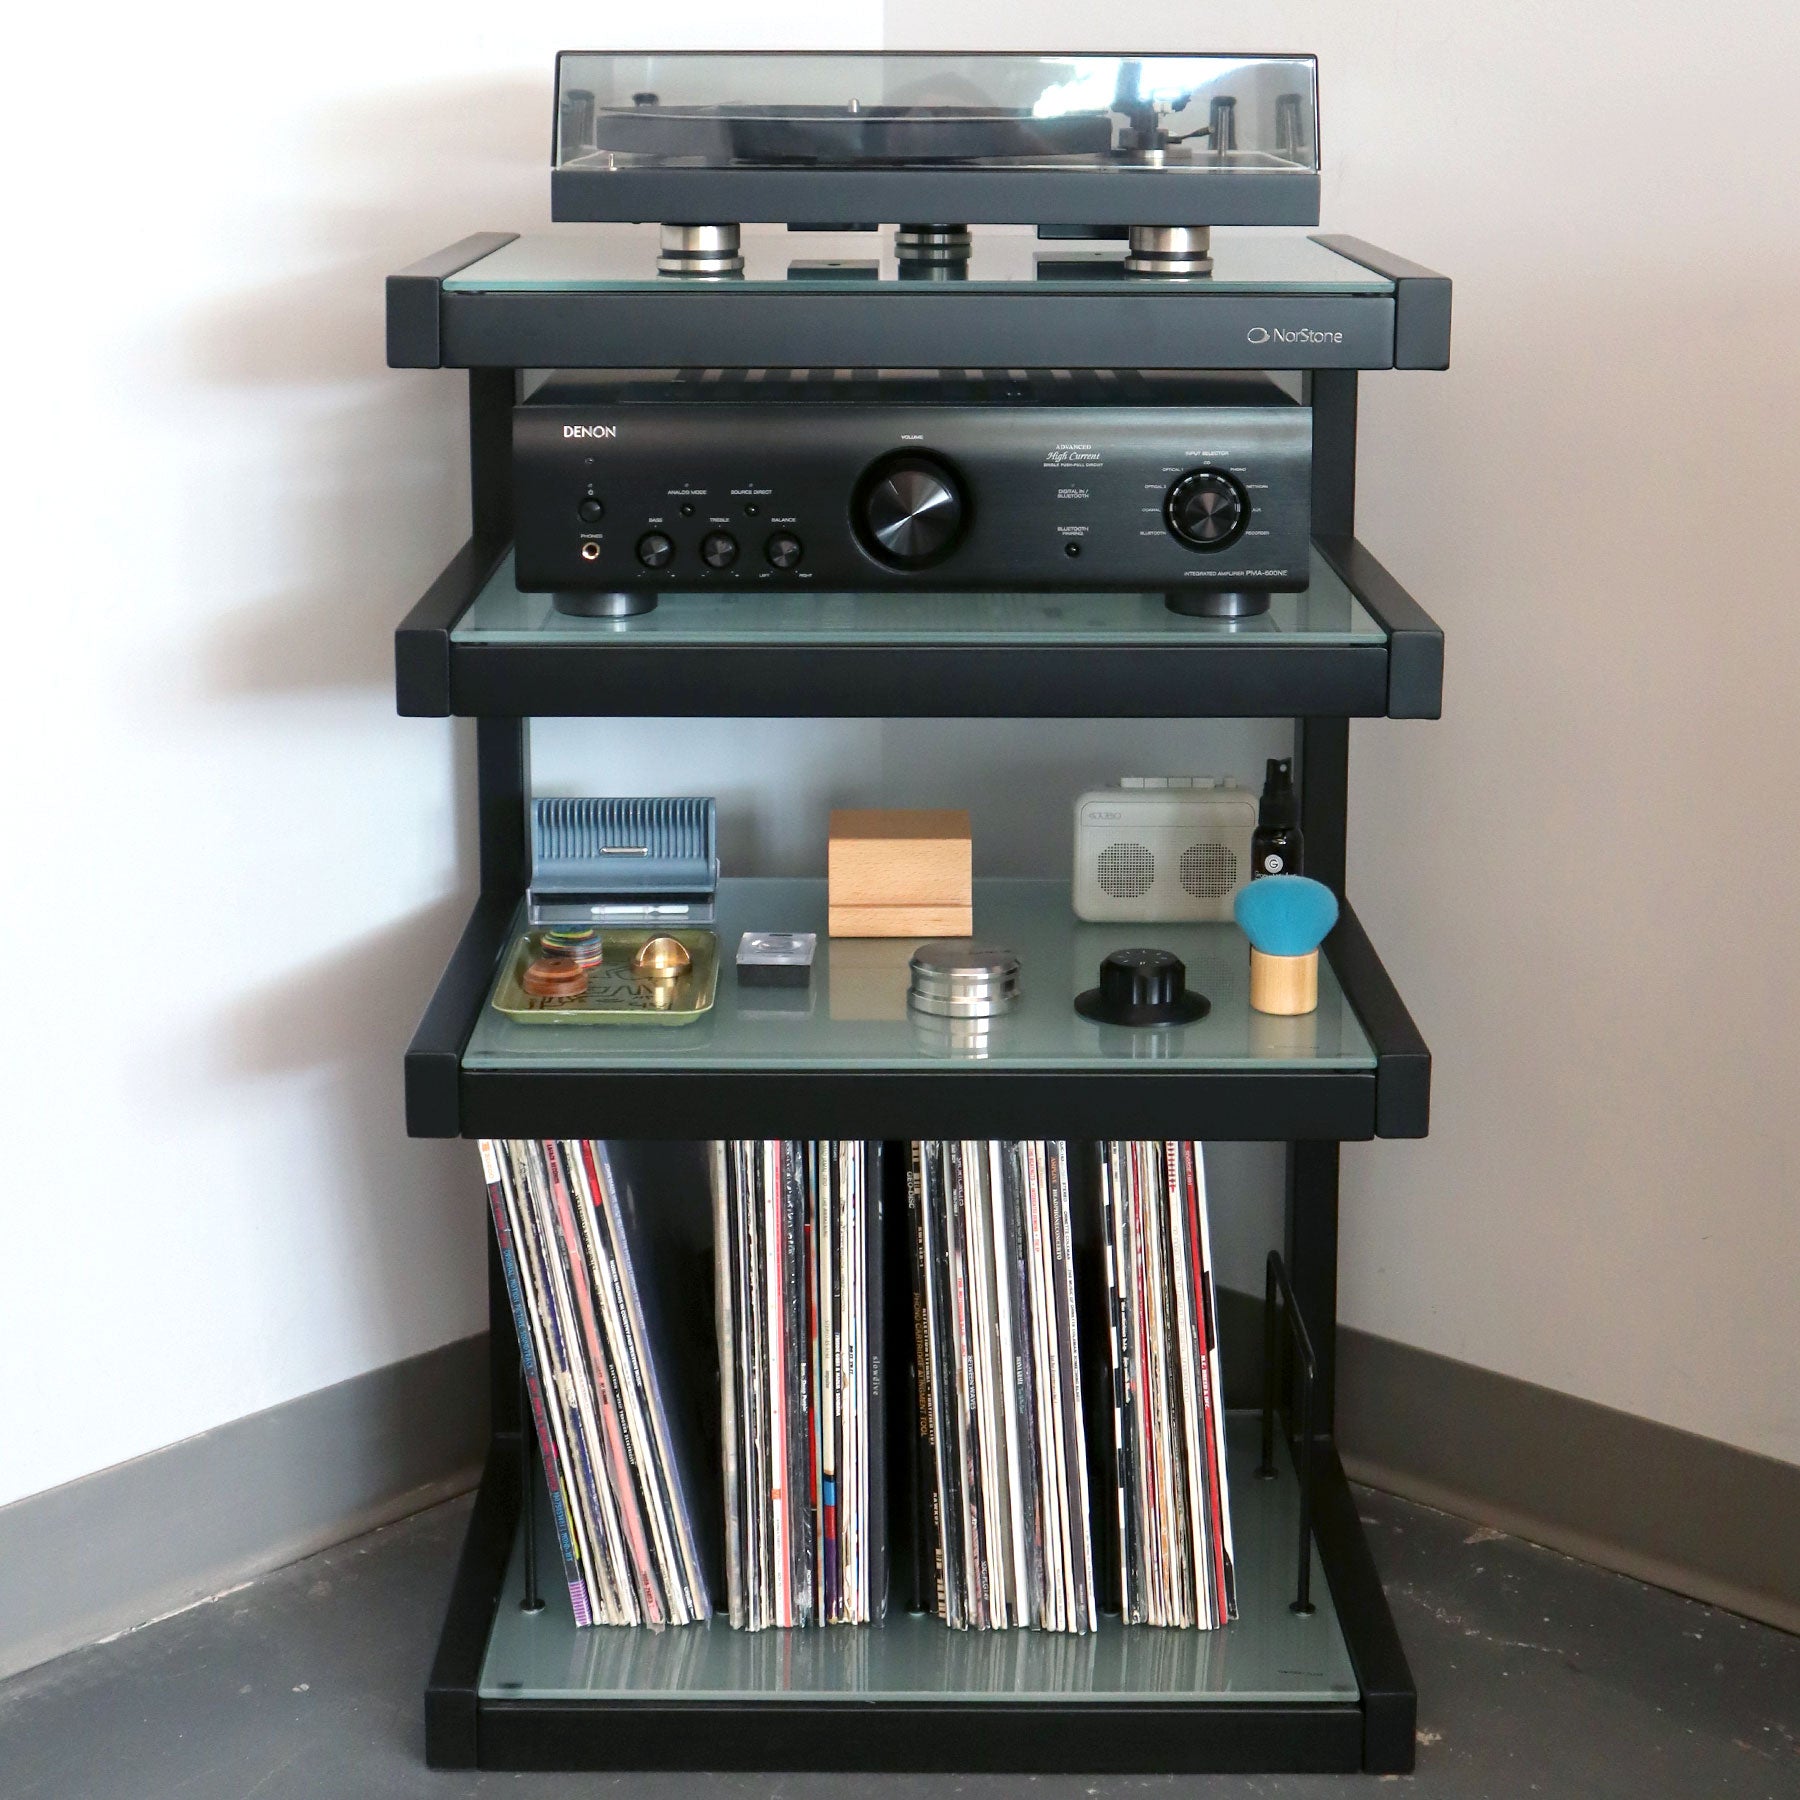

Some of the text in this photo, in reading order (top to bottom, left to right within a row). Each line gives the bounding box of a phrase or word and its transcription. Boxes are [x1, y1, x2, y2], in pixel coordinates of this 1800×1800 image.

[1274, 328, 1342, 342] NorStone
[564, 426, 616, 438] DENON
[1046, 451, 1100, 462] High Current
[1270, 859, 1278, 868] G
[906, 1171, 914, 1208] GEO-DISC
[609, 1259, 618, 1281] MODERN
[613, 1281, 622, 1304] SOUNDS
[503, 1249, 533, 1369] ORIGINAL MOTION PICTURE SOUNDTRACK
[912, 1292, 921, 1321] PHONO
[620, 1310, 630, 1334] COUNTRY
[914, 1323, 923, 1366] CARTRIDGE
[628, 1345, 638, 1370] WESTERN
[633, 1370, 642, 1386] MUSIC
[872, 1355, 880, 1395] slowdive
